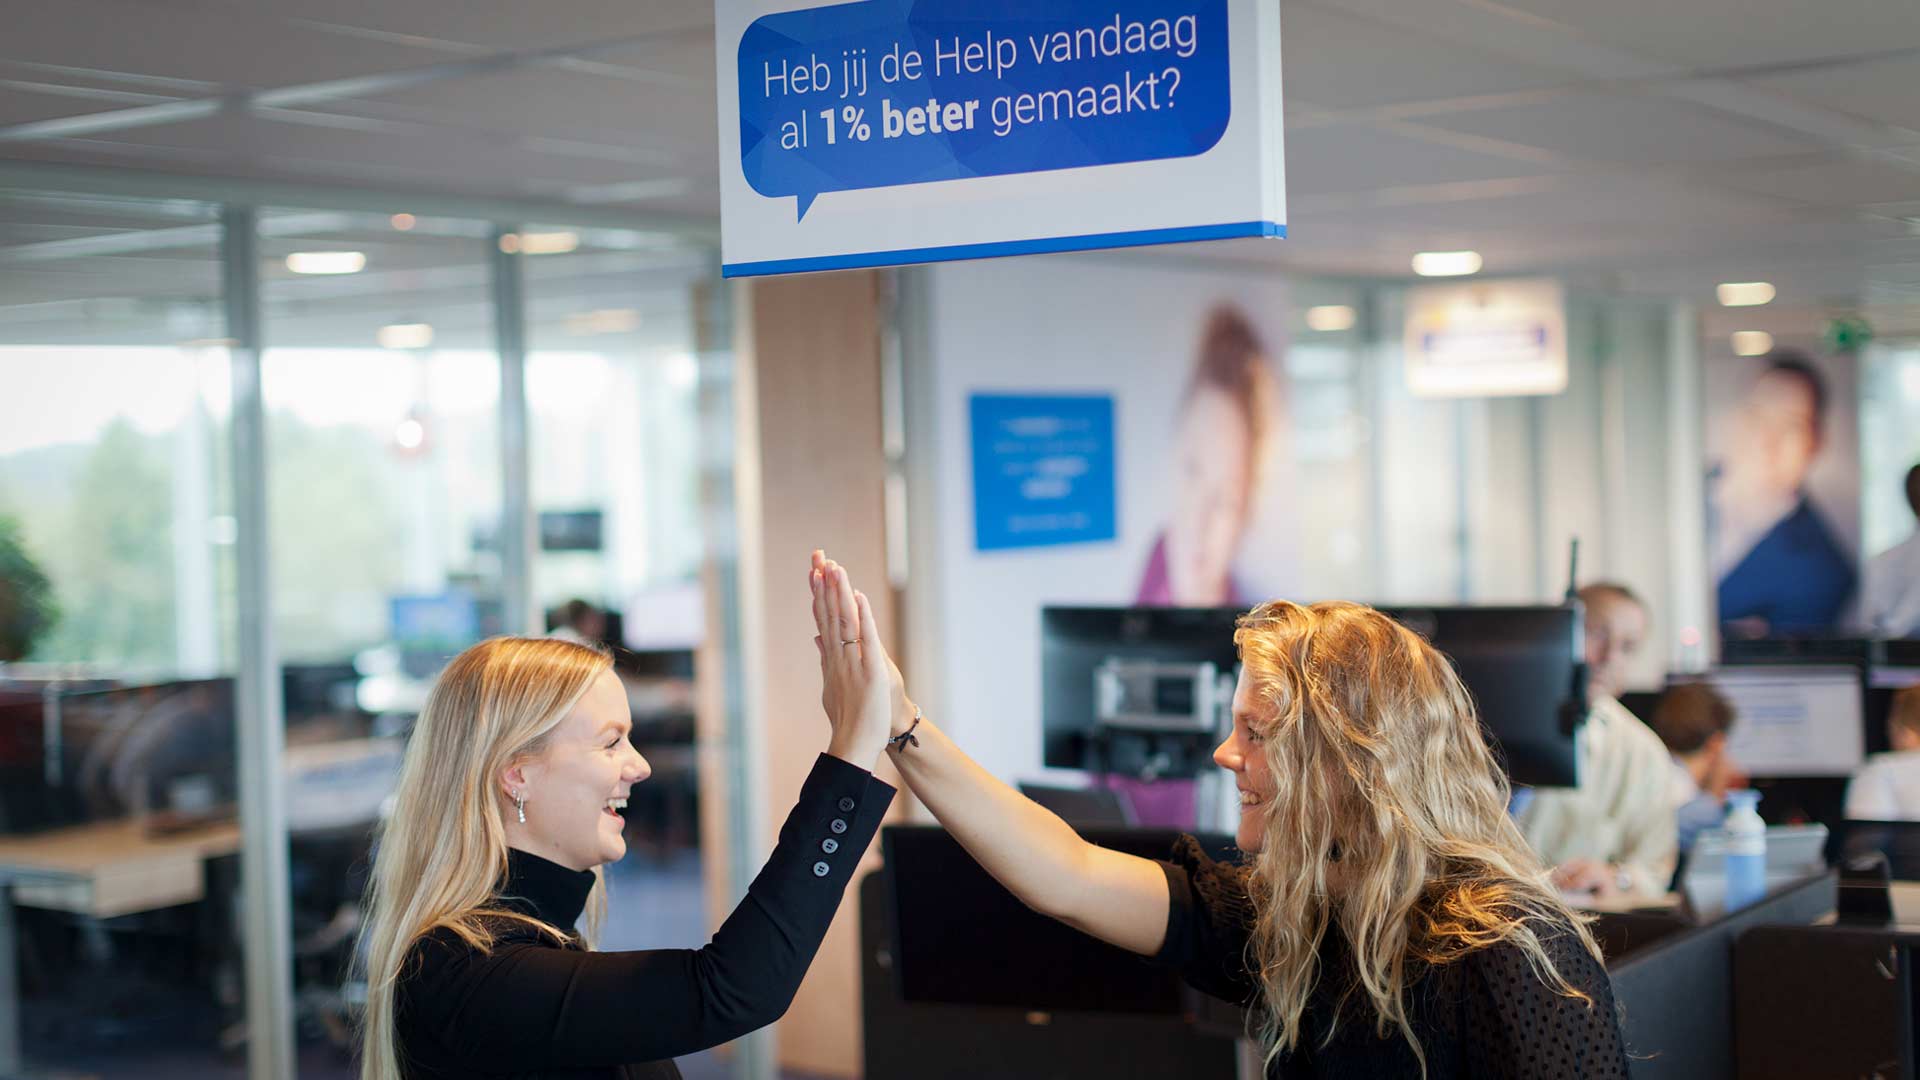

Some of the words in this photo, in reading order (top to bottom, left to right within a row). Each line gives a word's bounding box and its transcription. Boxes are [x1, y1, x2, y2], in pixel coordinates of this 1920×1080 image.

[764, 55, 832, 97] Heb
[839, 48, 868, 98] jij
[880, 42, 923, 83] de
[935, 30, 1017, 79] Help
[1029, 13, 1198, 64] vandaag
[780, 110, 807, 150] al
[819, 105, 871, 146] 1%
[882, 98, 979, 139] beter
[991, 66, 1182, 136] gemaakt?
